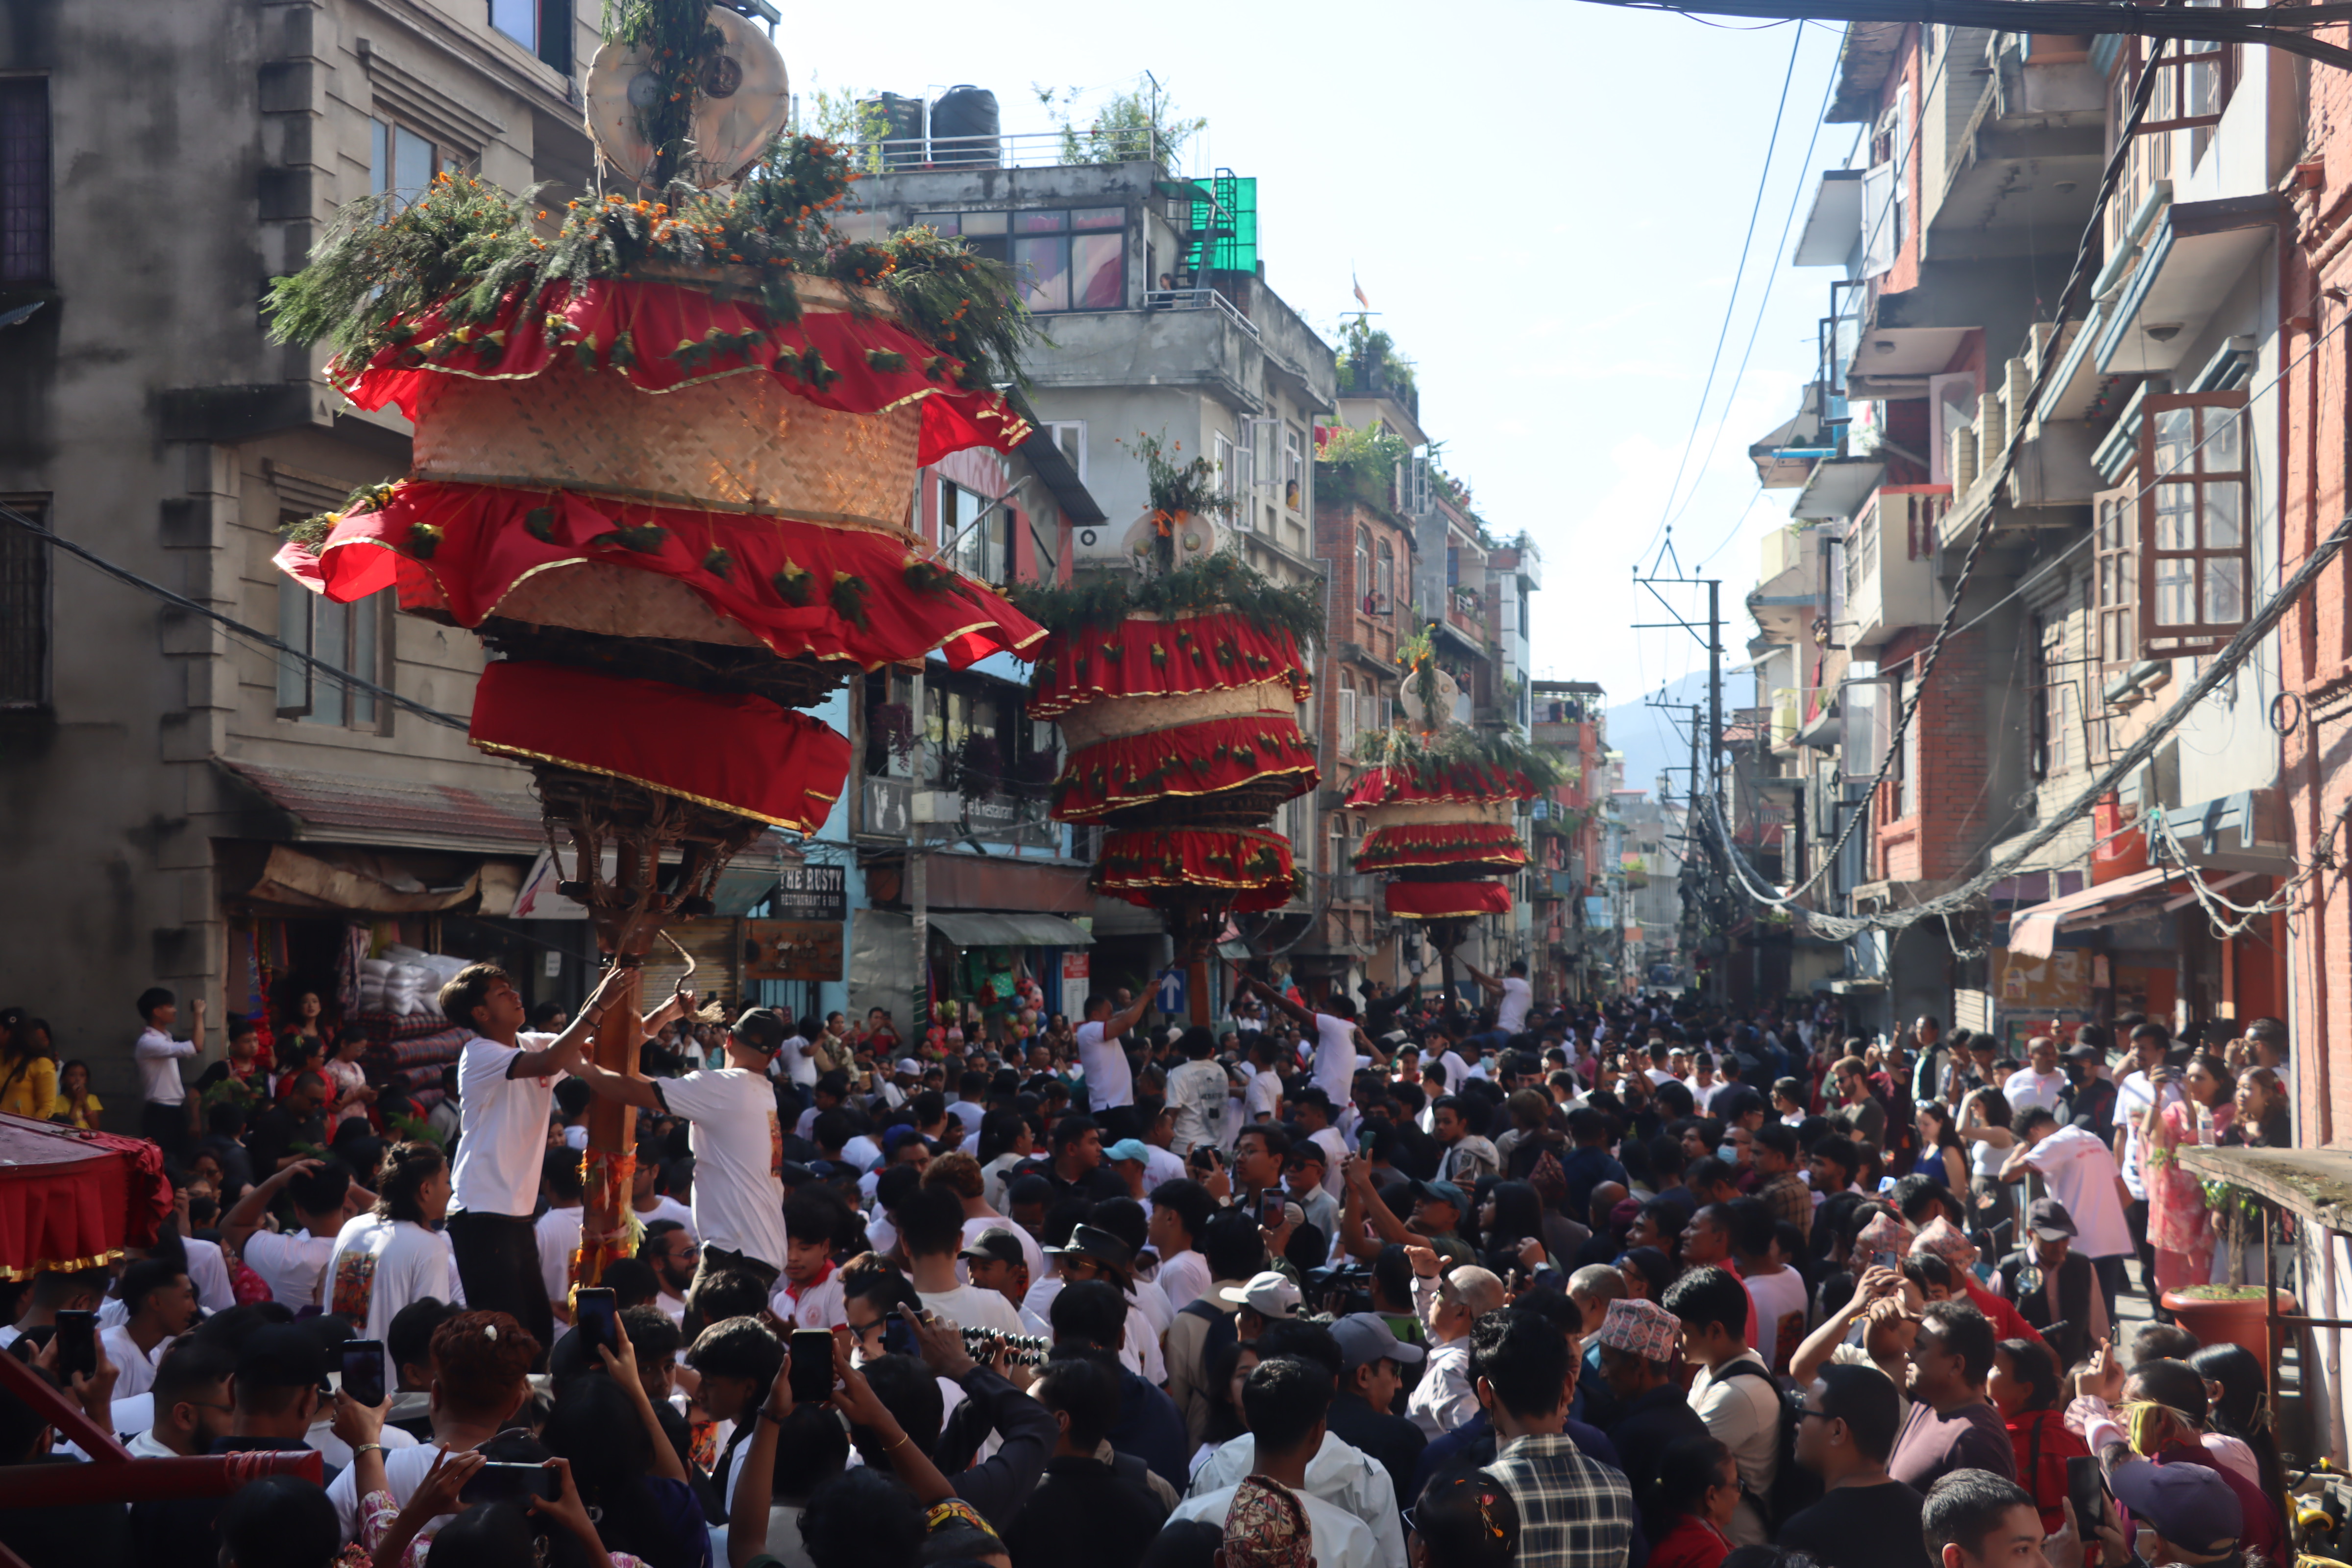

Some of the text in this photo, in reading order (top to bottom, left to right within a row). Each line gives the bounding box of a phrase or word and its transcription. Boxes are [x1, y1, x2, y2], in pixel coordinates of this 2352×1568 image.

[781, 868, 842, 891] THE RUSTY
[781, 894, 820, 906] RESTAURANT
[828, 895, 839, 906] BAR
